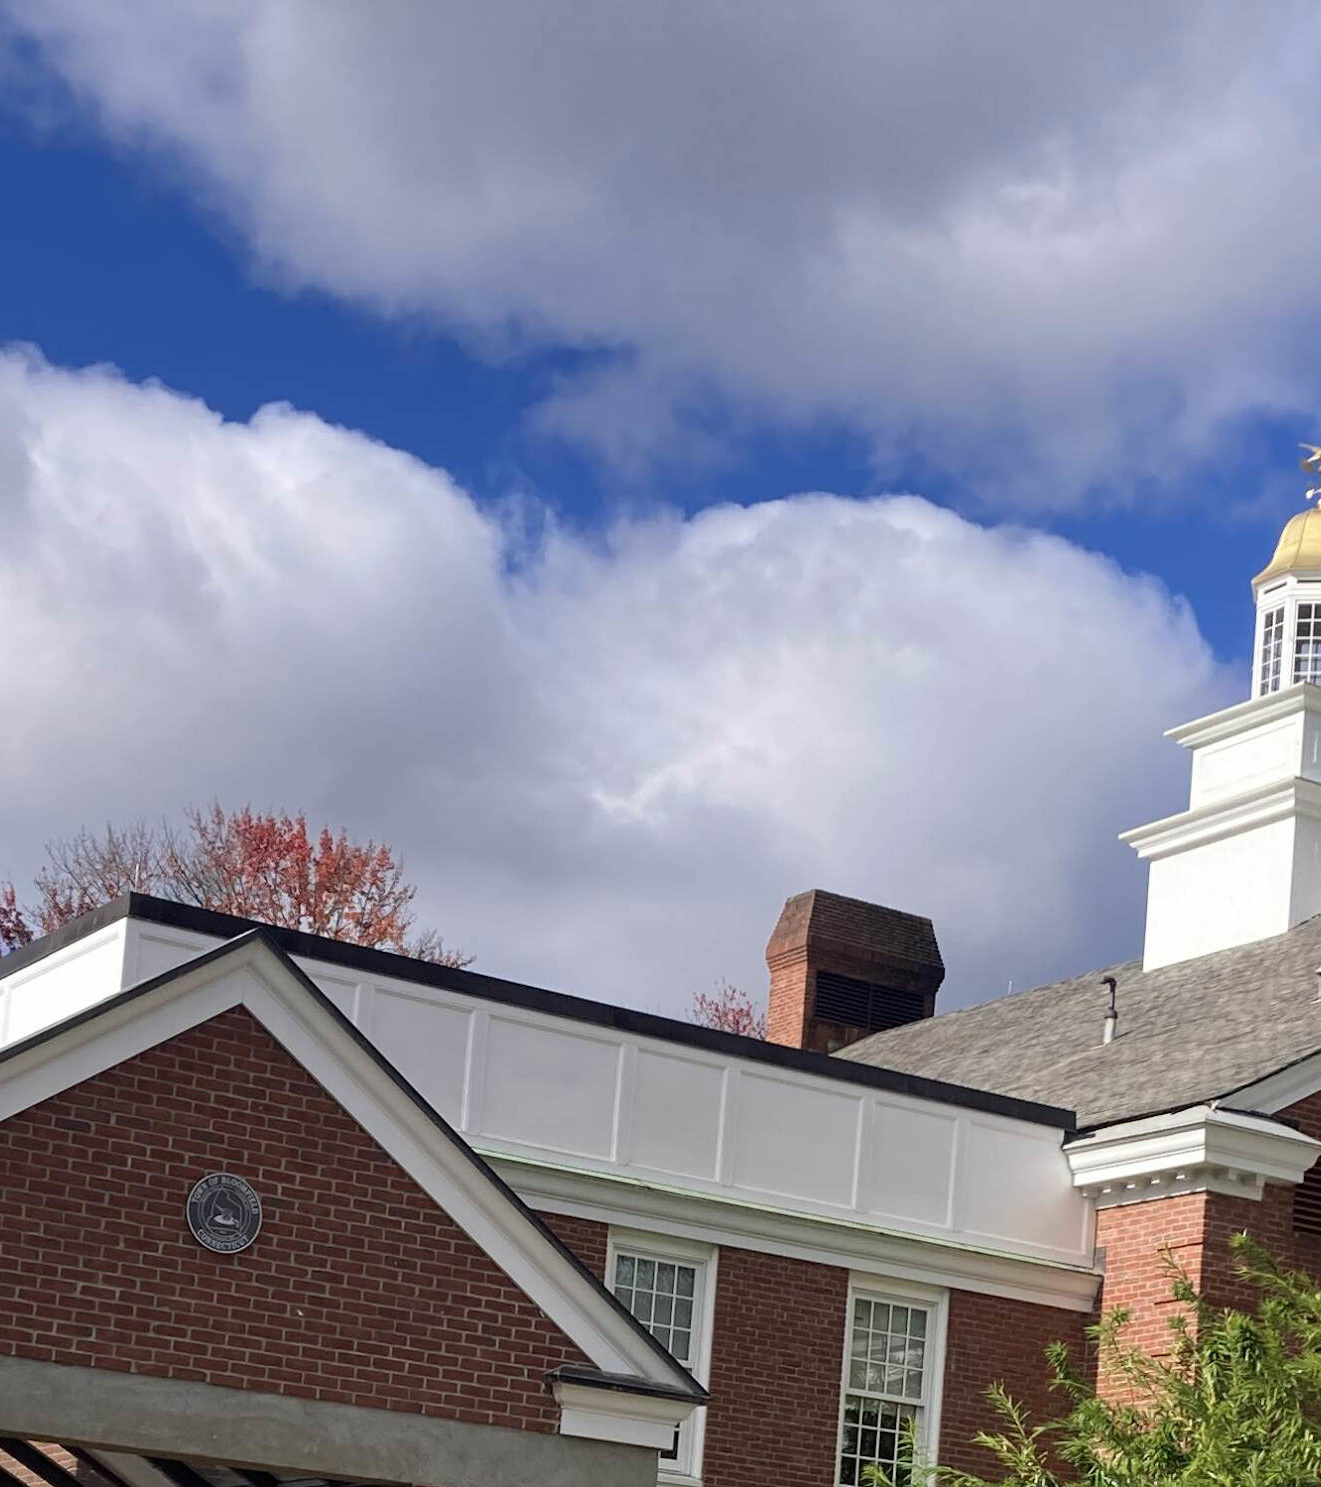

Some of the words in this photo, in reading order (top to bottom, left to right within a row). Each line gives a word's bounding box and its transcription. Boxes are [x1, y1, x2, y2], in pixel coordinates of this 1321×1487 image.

[192, 1183, 207, 1203] TOWN
[208, 1177, 218, 1185] OF
[221, 1176, 259, 1215] BLOOMFIELD
[197, 1229, 249, 1250] CONNECTICUT
